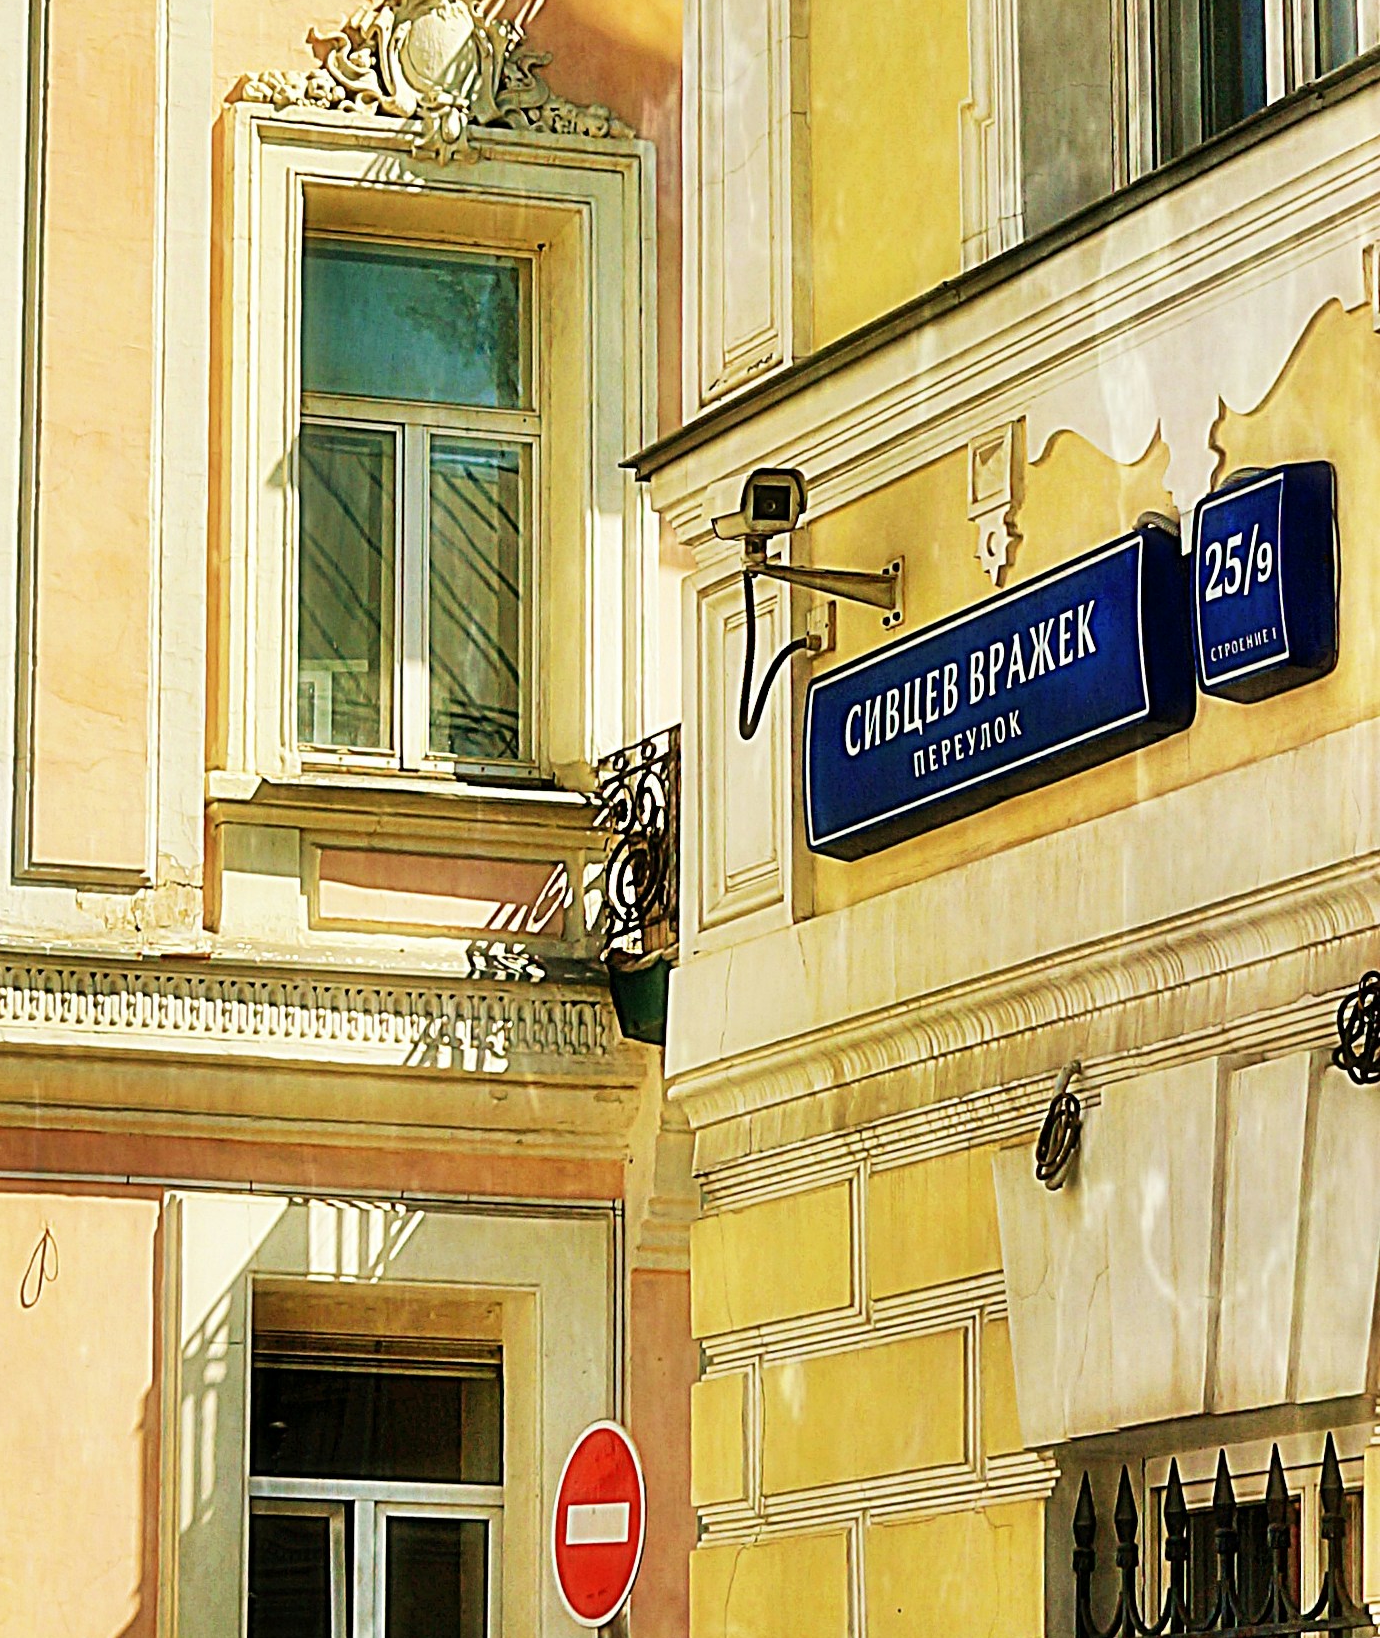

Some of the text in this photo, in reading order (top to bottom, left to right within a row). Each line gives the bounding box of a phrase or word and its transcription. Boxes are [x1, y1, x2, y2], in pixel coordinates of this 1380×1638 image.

[1205, 523, 1273, 602] 25/9
[845, 600, 1098, 757] СИВЦЕВ ВРАЖЕК
[1210, 628, 1269, 662] СТРОЕНИЕ
[913, 709, 1023, 778] ПЕРЕУЛОК
